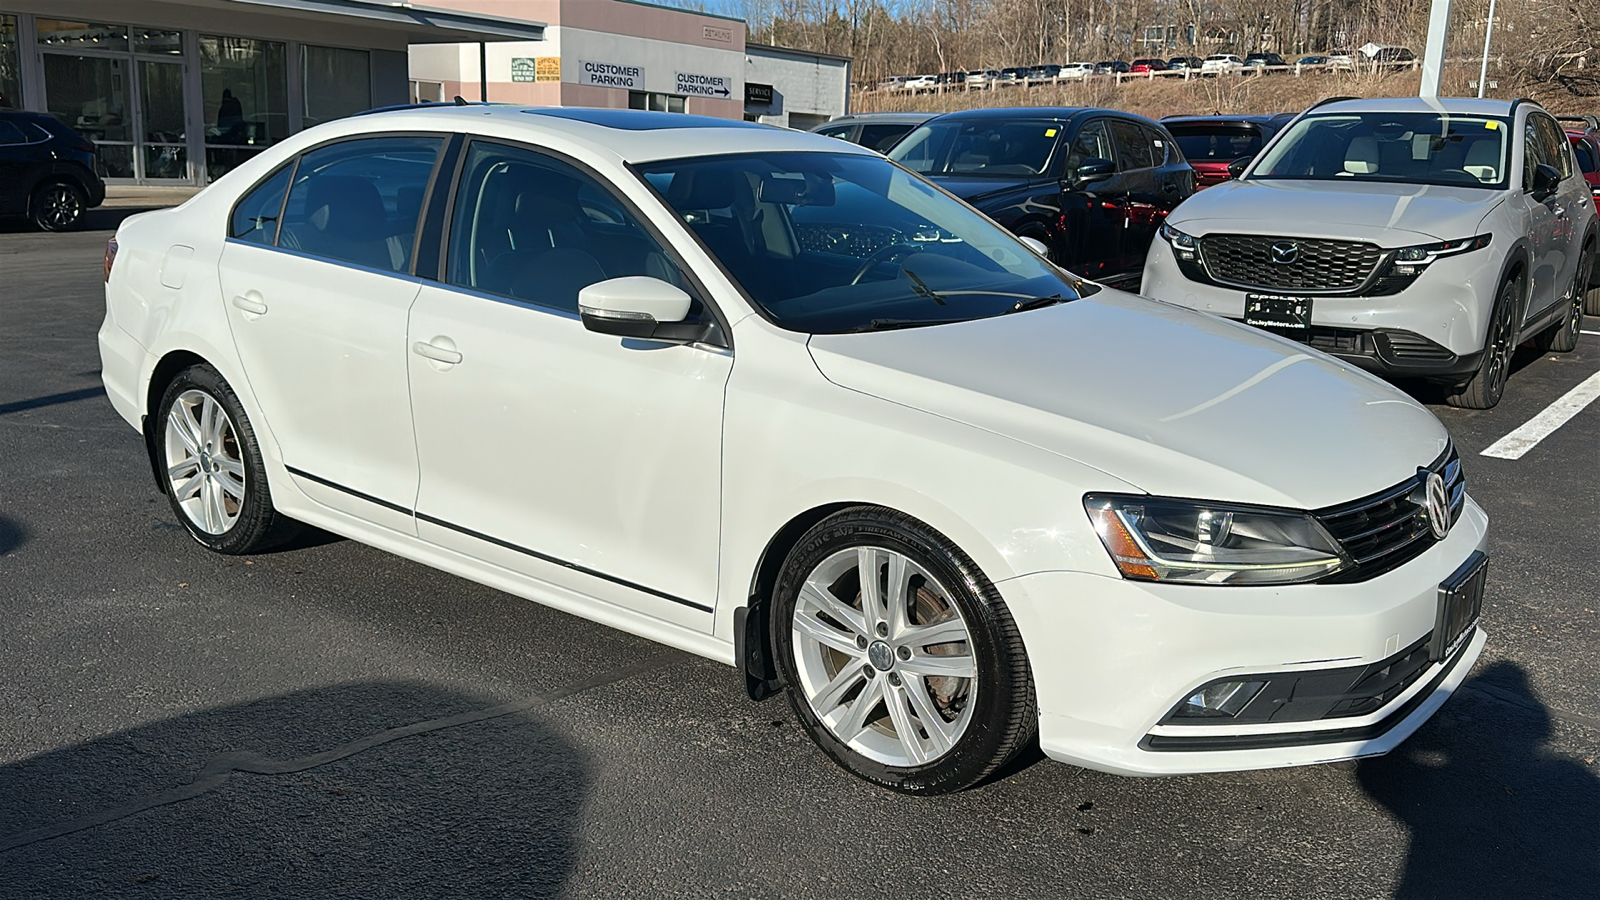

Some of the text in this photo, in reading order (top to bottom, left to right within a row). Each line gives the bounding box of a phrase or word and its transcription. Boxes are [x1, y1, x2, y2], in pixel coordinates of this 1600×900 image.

[705, 28, 731, 40] DETAILING
[585, 62, 639, 77] CUSTOMER
[591, 74, 633, 87] PARKING
[677, 73, 723, 86] CUSTOMER
[677, 84, 714, 95] PARKING
[749, 87, 771, 97] SERVICE
[1247, 318, 1305, 329] CooleyMotors.com
[858, 526, 909, 543] FIREHAWK
[782, 533, 831, 588] Frestone
